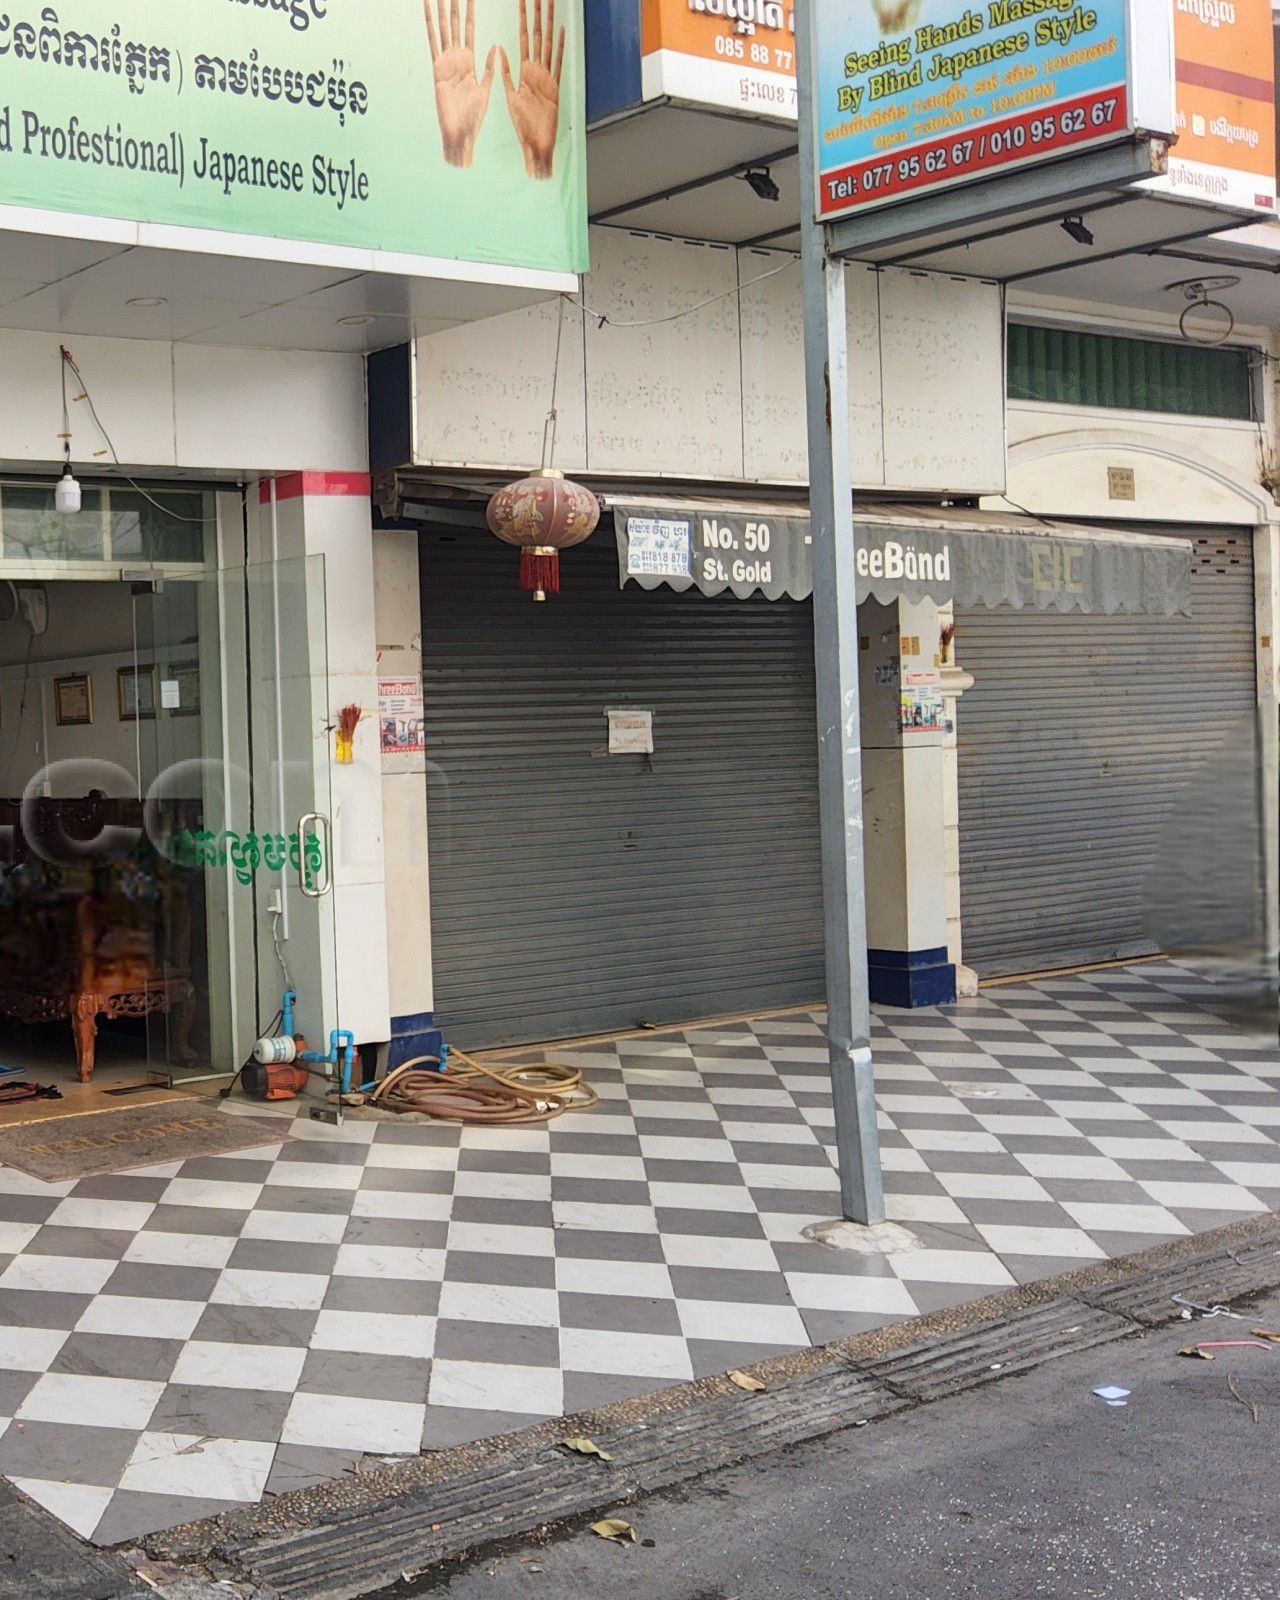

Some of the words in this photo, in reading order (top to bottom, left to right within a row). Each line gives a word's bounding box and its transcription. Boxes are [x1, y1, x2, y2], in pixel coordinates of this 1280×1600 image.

[714, 35, 744, 60] 085
[750, 43, 769, 65] 88
[838, 85, 864, 114] By
[869, 64, 924, 103] Blind
[927, 31, 1029, 82] Japanese
[1034, 7, 1098, 51] Style
[844, 41, 911, 77] Seeing
[915, 11, 982, 54] Hands
[988, 0, 1071, 28] Massag
[22, 110, 184, 189] Profestional)
[193, 137, 304, 195] Japanese
[312, 154, 369, 210] Style
[827, 181, 859, 202] Tel:
[862, 163, 895, 191] 077
[898, 156, 921, 181] 95
[924, 148, 948, 173] 62
[951, 139, 974, 166] 67
[977, 135, 986, 159] /
[990, 125, 1026, 154] 010
[1030, 119, 1056, 144] 95
[1060, 108, 1086, 135] 62
[1091, 98, 1117, 126] 67
[702, 520, 739, 550] No.
[744, 522, 770, 553] 50
[703, 558, 729, 581] St.
[732, 560, 772, 583] Gold
